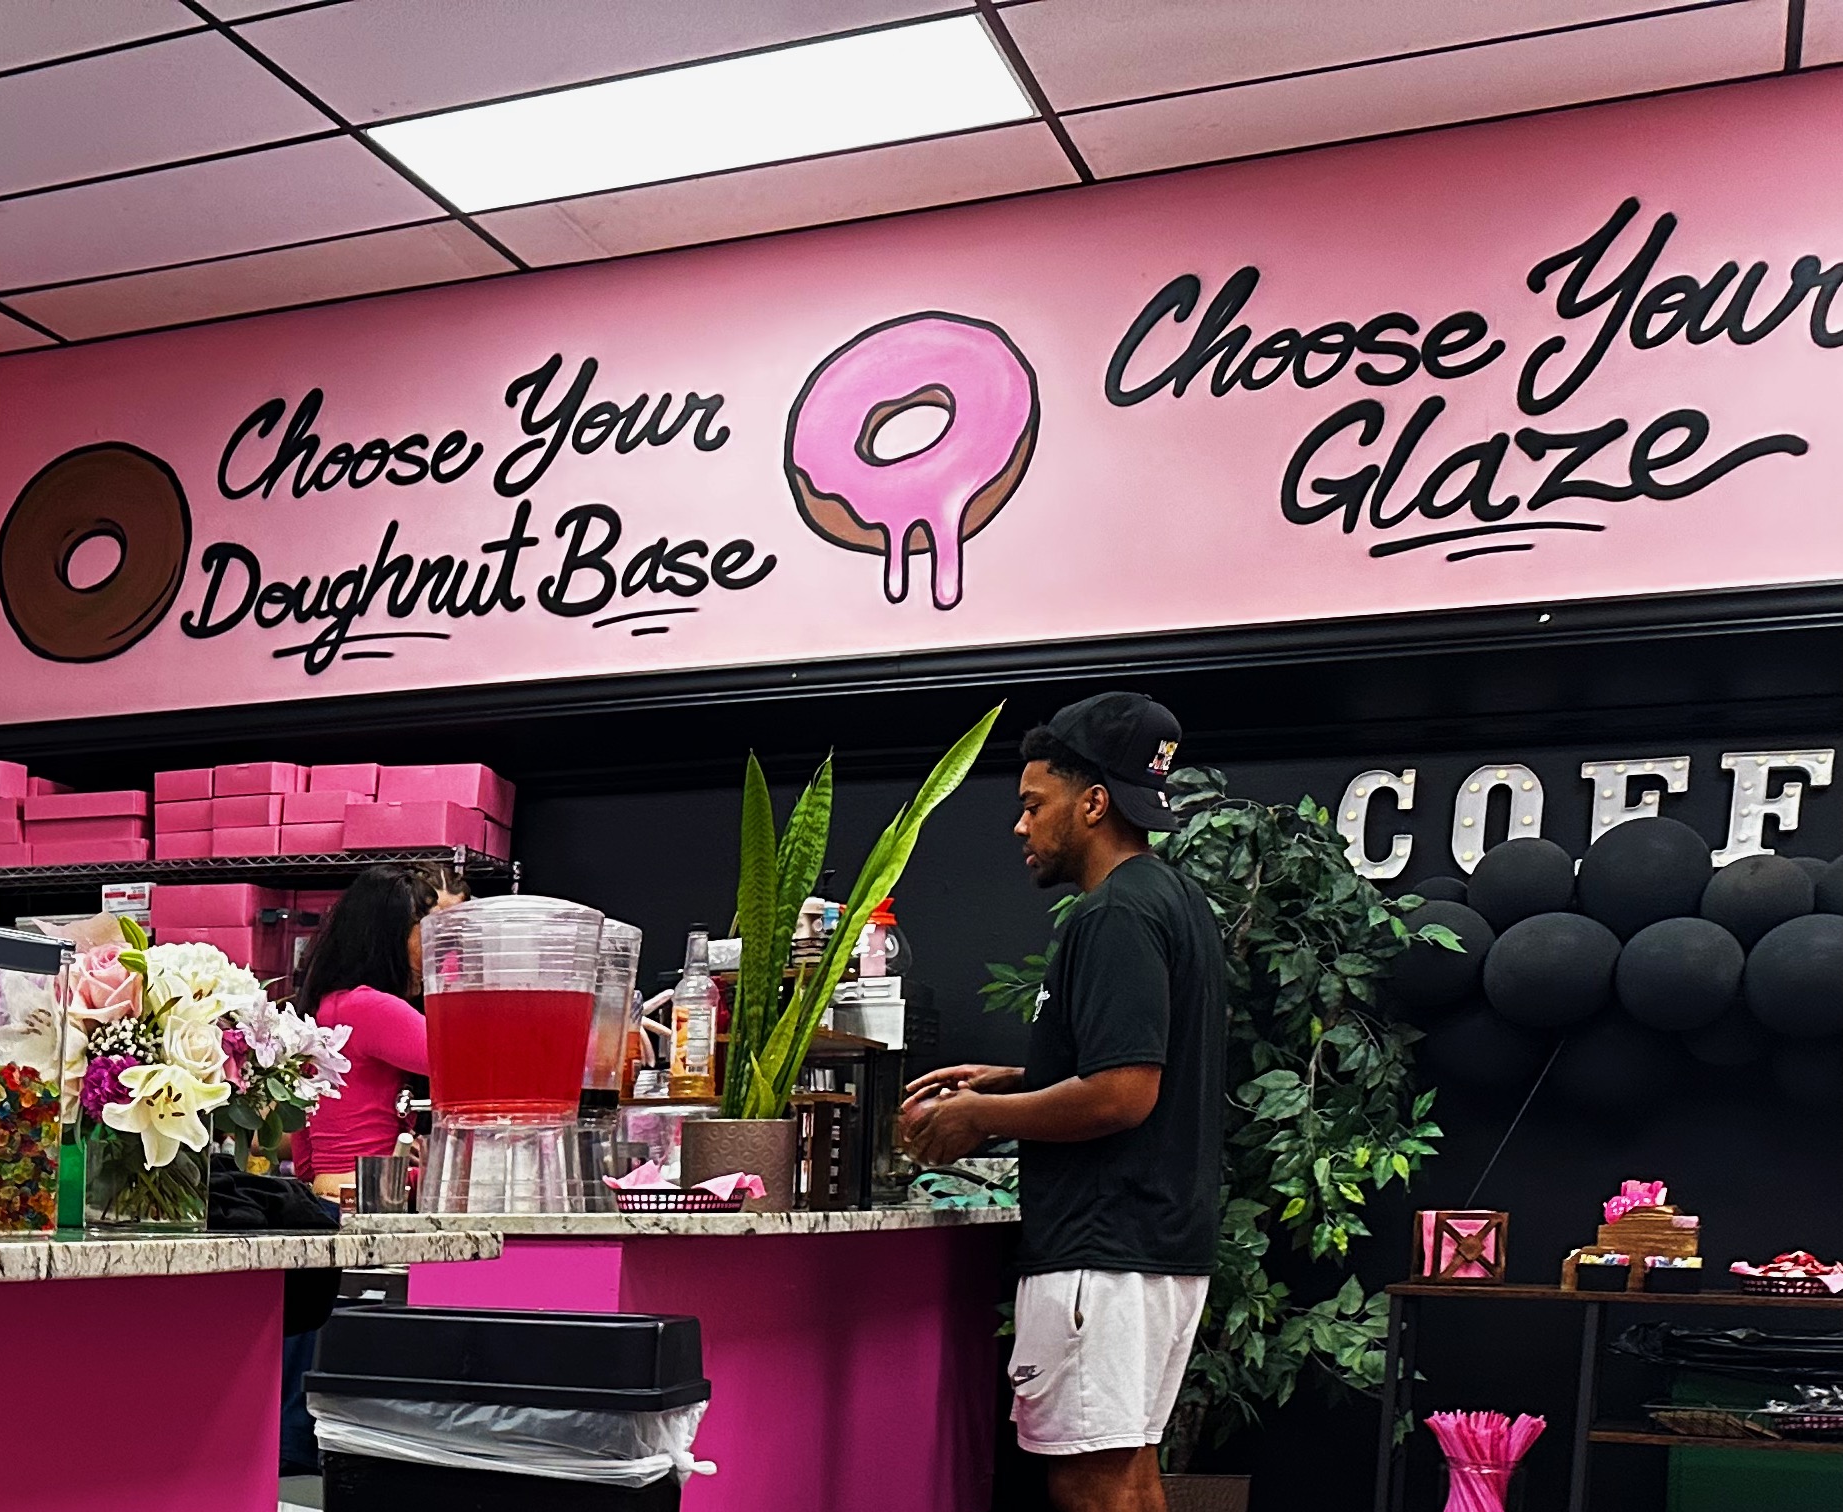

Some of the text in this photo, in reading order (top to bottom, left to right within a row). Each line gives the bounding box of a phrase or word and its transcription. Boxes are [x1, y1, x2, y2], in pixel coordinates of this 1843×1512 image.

[1104, 196, 1843, 416] Choose Your
[217, 353, 732, 500] Choose Your
[1280, 396, 1809, 535] Glaze
[180, 500, 779, 675] Doughnut Base
